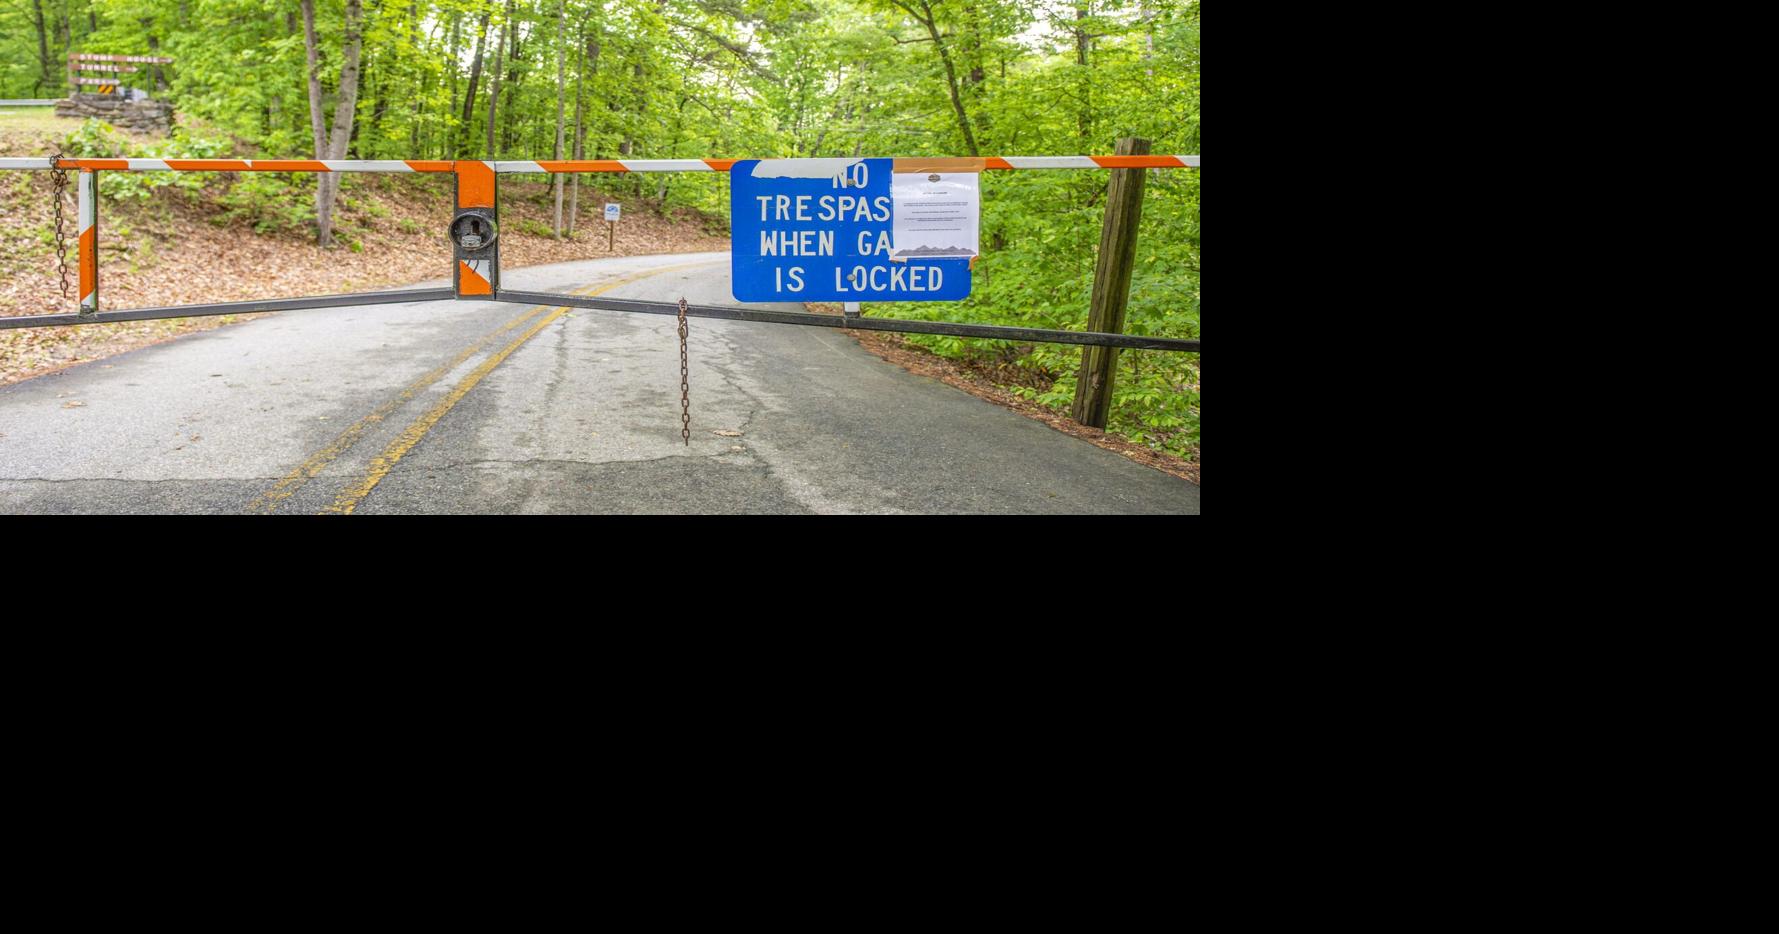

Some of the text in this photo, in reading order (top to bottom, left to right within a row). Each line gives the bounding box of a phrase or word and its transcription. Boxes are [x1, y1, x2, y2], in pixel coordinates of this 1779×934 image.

[832, 162, 869, 189] NO
[756, 194, 891, 222] TRESPAS
[760, 230, 893, 257] WHEN GA
[775, 265, 943, 292] IS LOCKED
